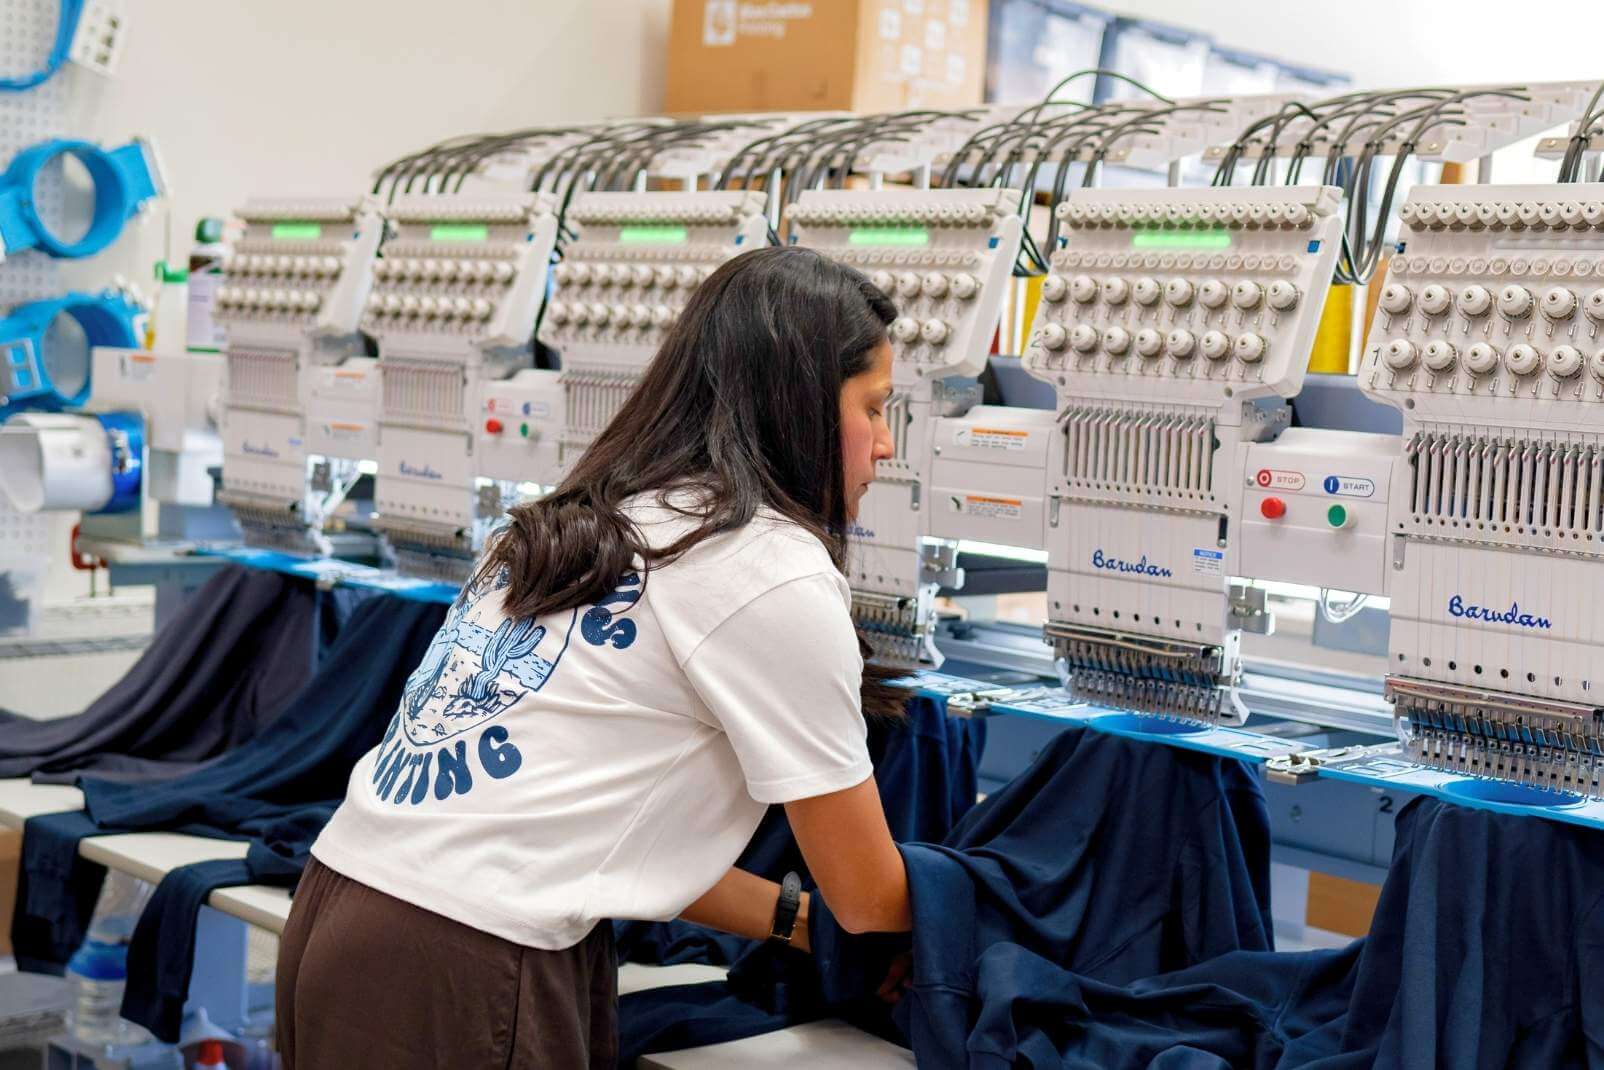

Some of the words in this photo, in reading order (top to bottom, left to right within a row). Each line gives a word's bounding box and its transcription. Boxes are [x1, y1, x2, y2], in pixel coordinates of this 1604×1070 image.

[1372, 346, 1381, 366] 1
[1276, 476, 1300, 485] STOP
[1343, 483, 1370, 491] START
[1093, 549, 1172, 577] Barudan
[1448, 594, 1552, 628] Barudan
[1379, 796, 1393, 813] 2
